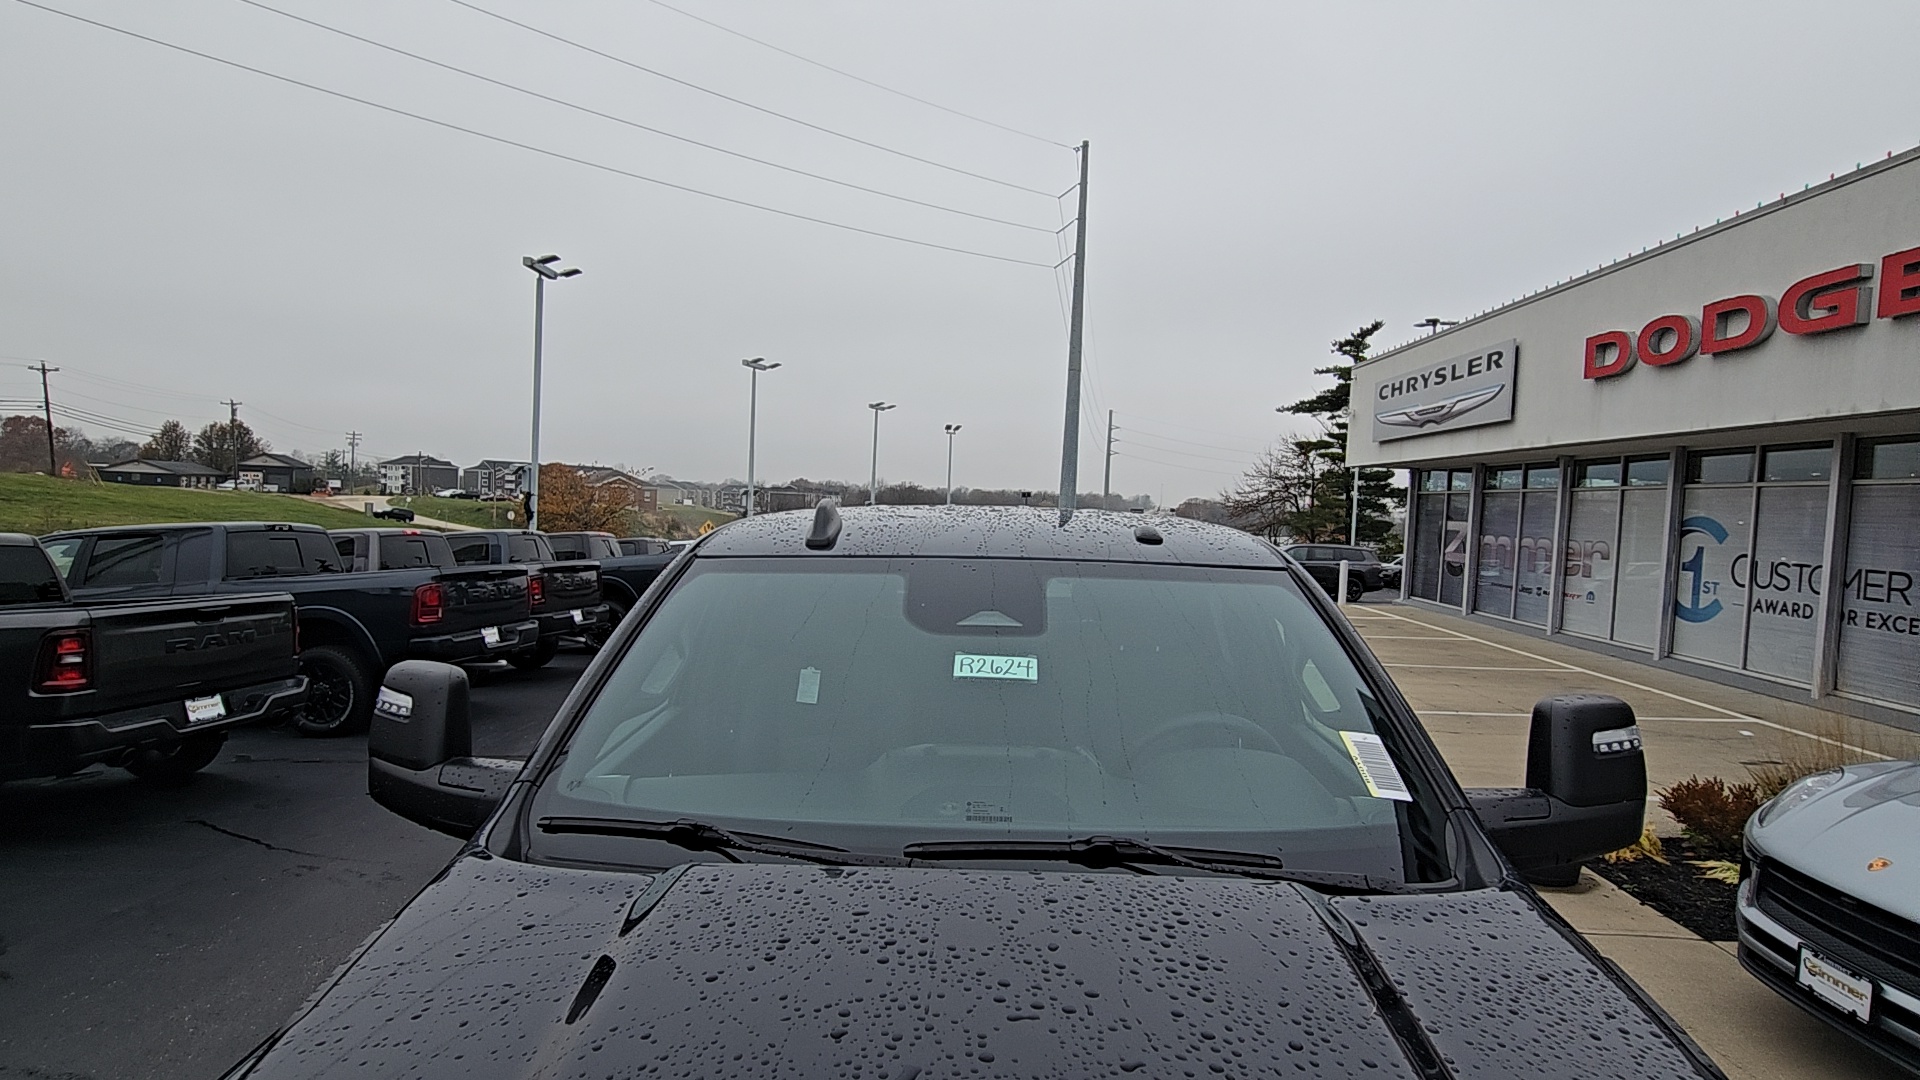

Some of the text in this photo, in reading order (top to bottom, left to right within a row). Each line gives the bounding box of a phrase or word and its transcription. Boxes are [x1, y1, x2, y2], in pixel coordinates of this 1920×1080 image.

[1583, 246, 1920, 380] DODGE
[1378, 350, 1505, 401] CHRYSLER
[1752, 598, 1814, 620] AWARD
[165, 628, 257, 654] RAM
[959, 656, 1034, 678] R2624
[1804, 956, 1869, 1002] Zimmer
